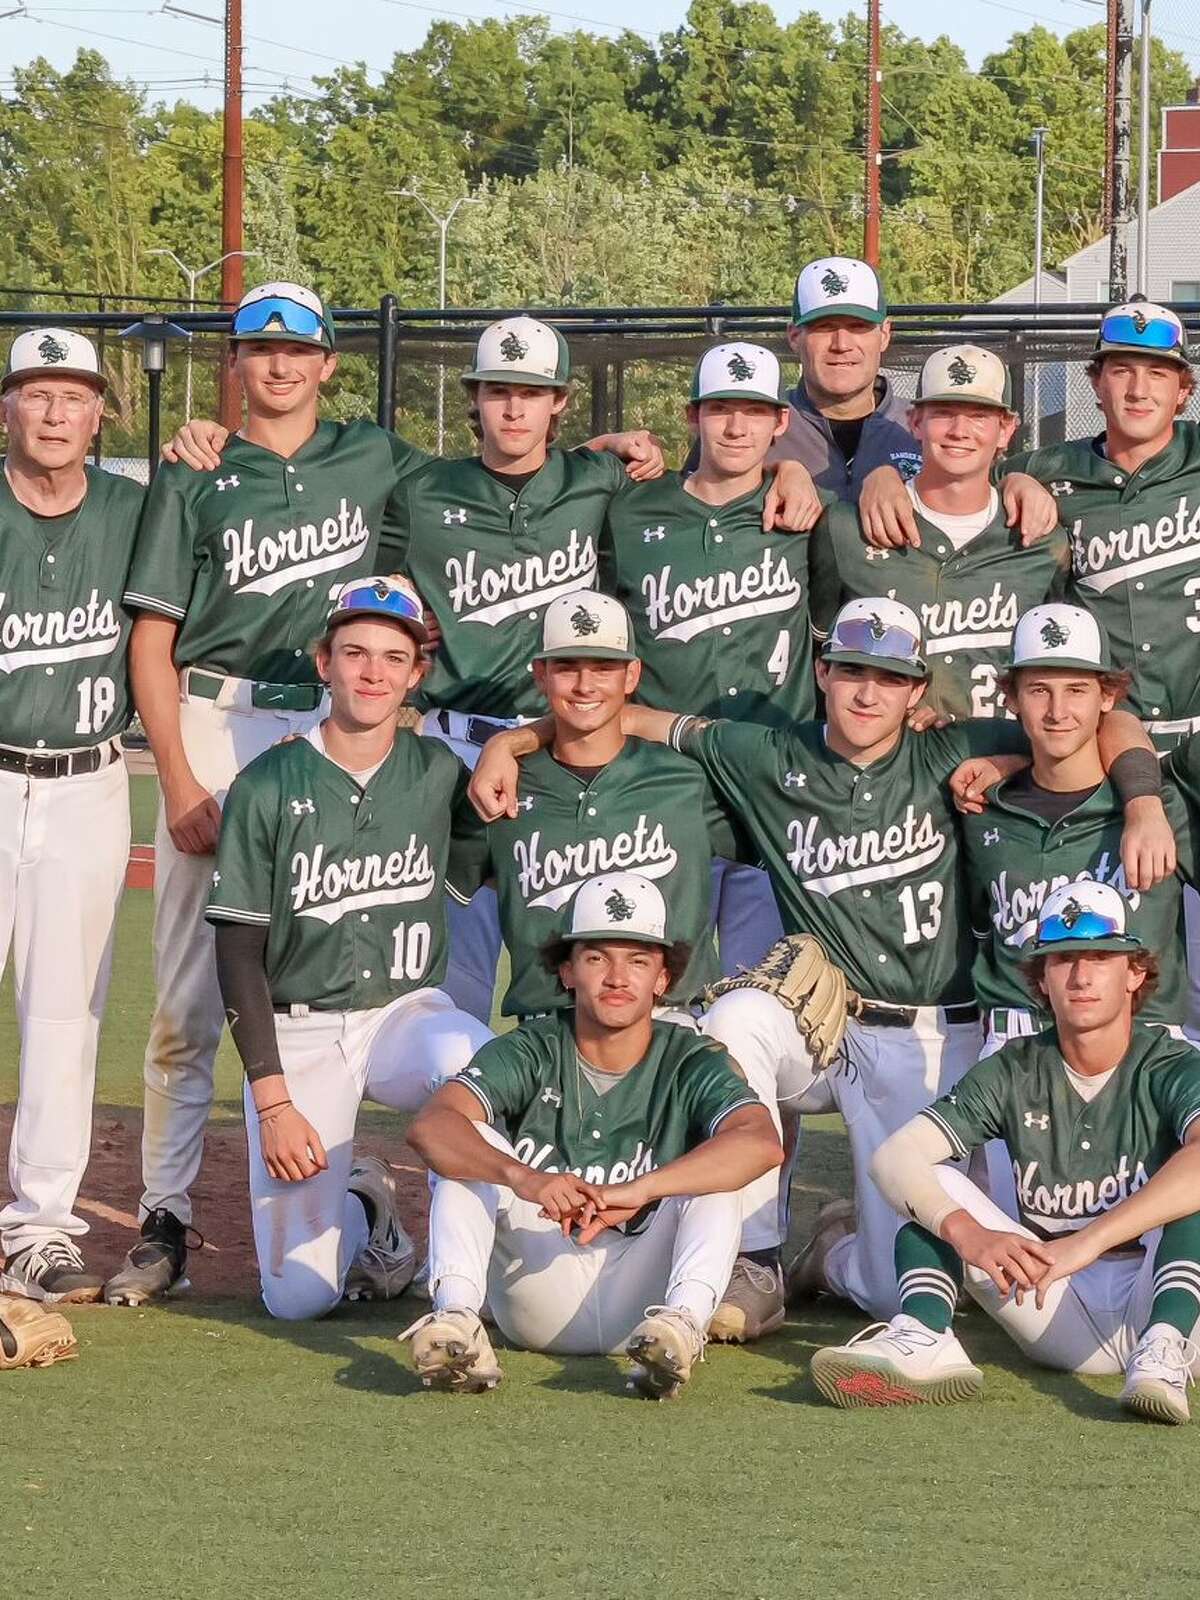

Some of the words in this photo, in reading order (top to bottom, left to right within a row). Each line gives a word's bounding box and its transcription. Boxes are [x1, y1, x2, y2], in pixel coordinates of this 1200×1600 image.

[224, 498, 369, 586] Hornets
[446, 528, 597, 613] Hornets
[0, 589, 120, 649] ornets
[642, 548, 797, 631] Hornets
[767, 629, 791, 686] 4
[75, 677, 116, 734] 18
[291, 834, 434, 910] Hornets
[514, 815, 674, 898] Hornets
[786, 804, 944, 876] Hornets
[898, 880, 943, 944] 13
[389, 921, 432, 980] 10
[1013, 1155, 1149, 1216] Hornets
